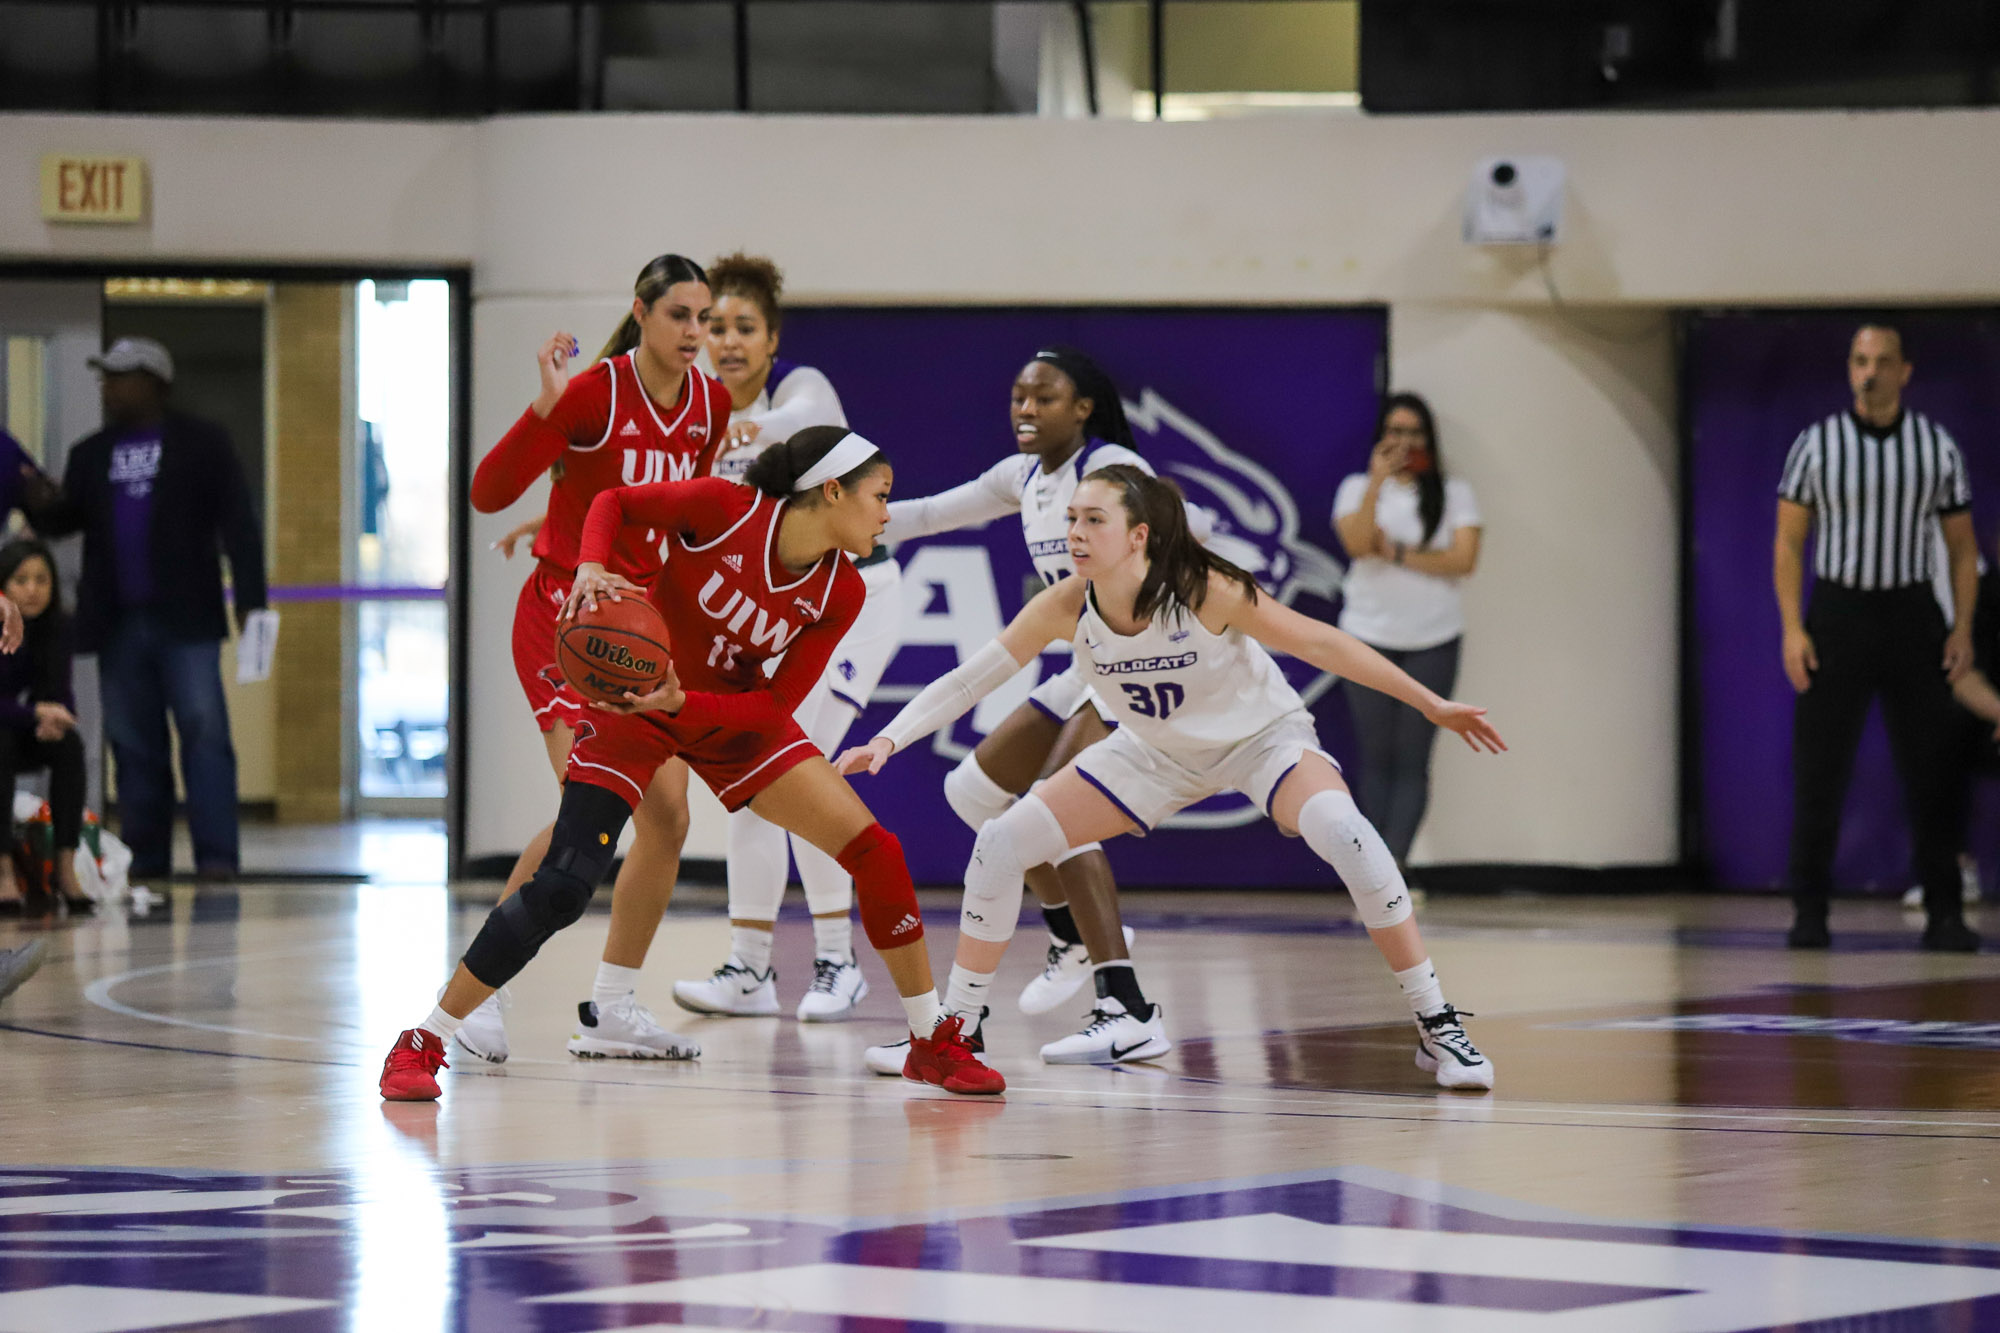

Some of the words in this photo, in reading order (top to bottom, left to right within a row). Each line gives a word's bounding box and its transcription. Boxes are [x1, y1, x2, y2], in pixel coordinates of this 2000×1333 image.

[58, 161, 127, 211] EXIT
[621, 448, 700, 487] UIW
[698, 569, 803, 654] UIW
[585, 634, 657, 675] Wilson
[1094, 651, 1198, 676] WILDCATS
[1120, 682, 1185, 720] 30
